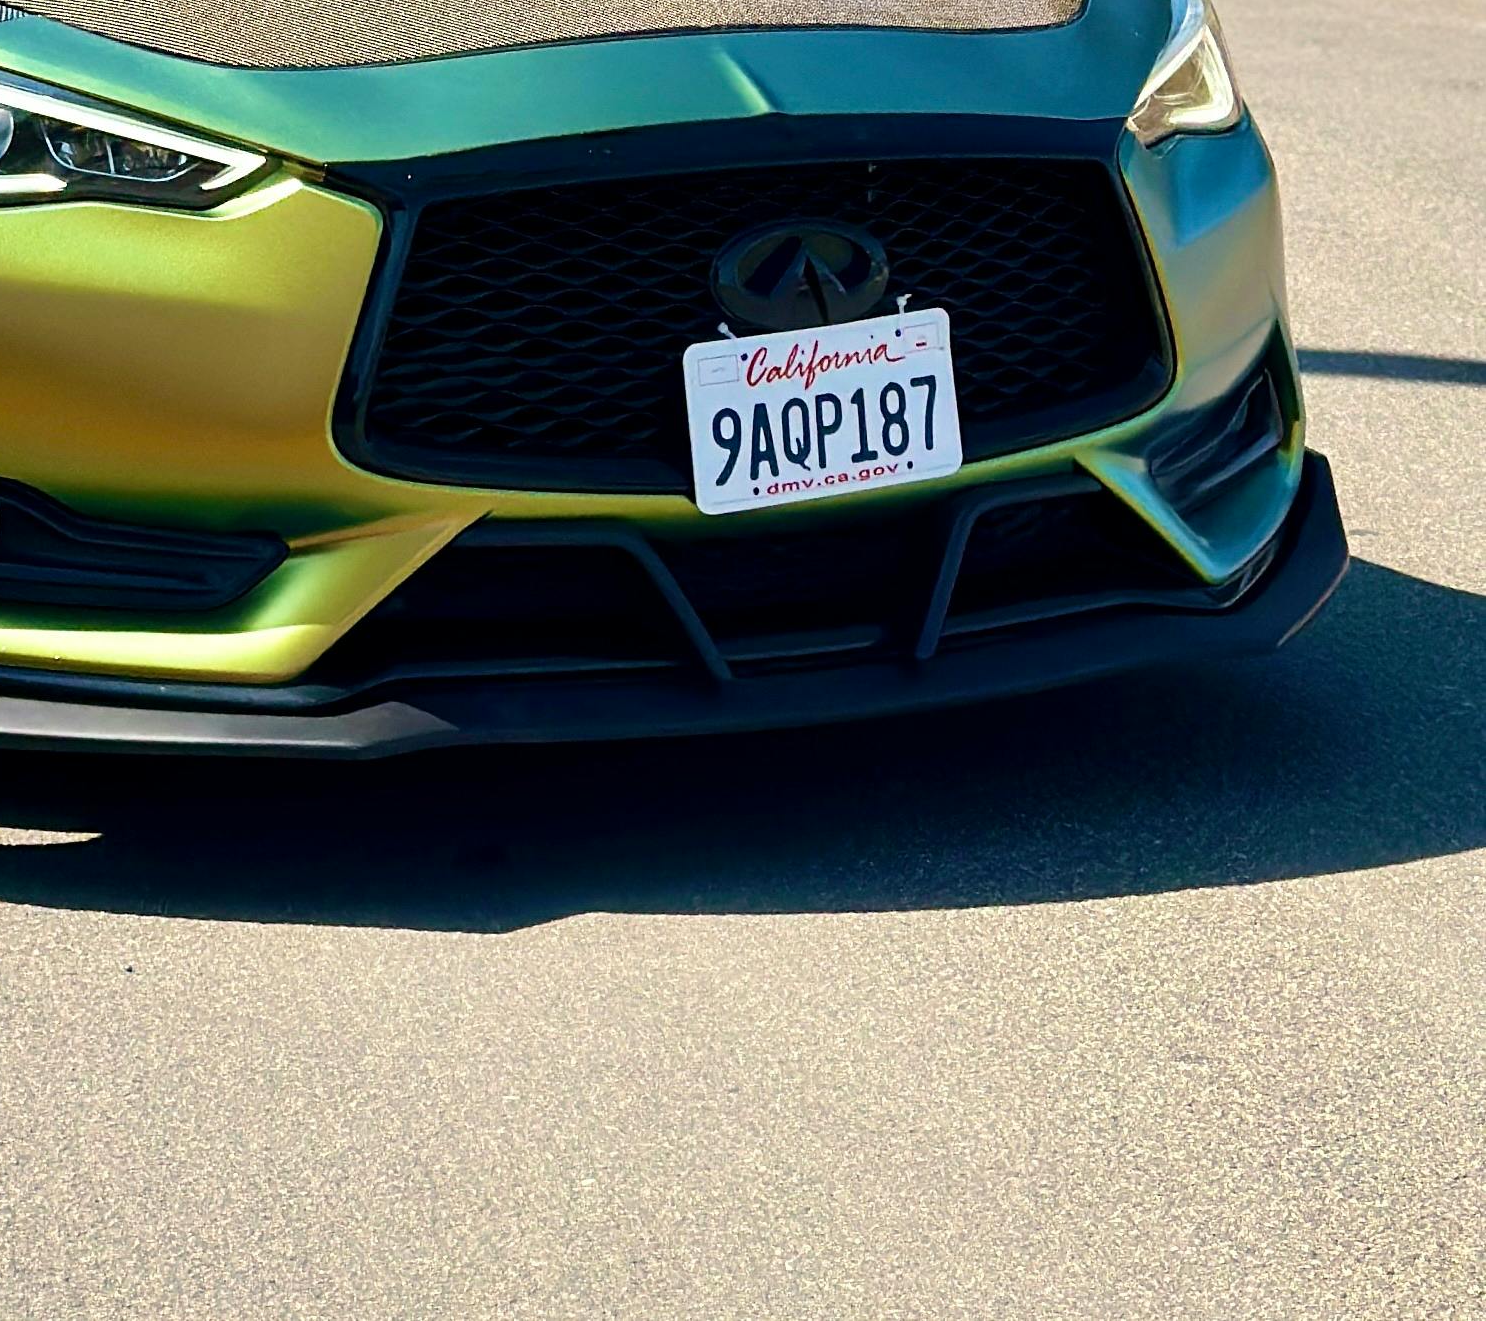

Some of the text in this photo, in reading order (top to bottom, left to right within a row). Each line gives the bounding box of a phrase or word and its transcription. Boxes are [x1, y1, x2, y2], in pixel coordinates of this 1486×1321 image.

[746, 338, 906, 390] California
[712, 375, 936, 486] 9AQP187
[766, 463, 899, 495] dmv.ca.gov
